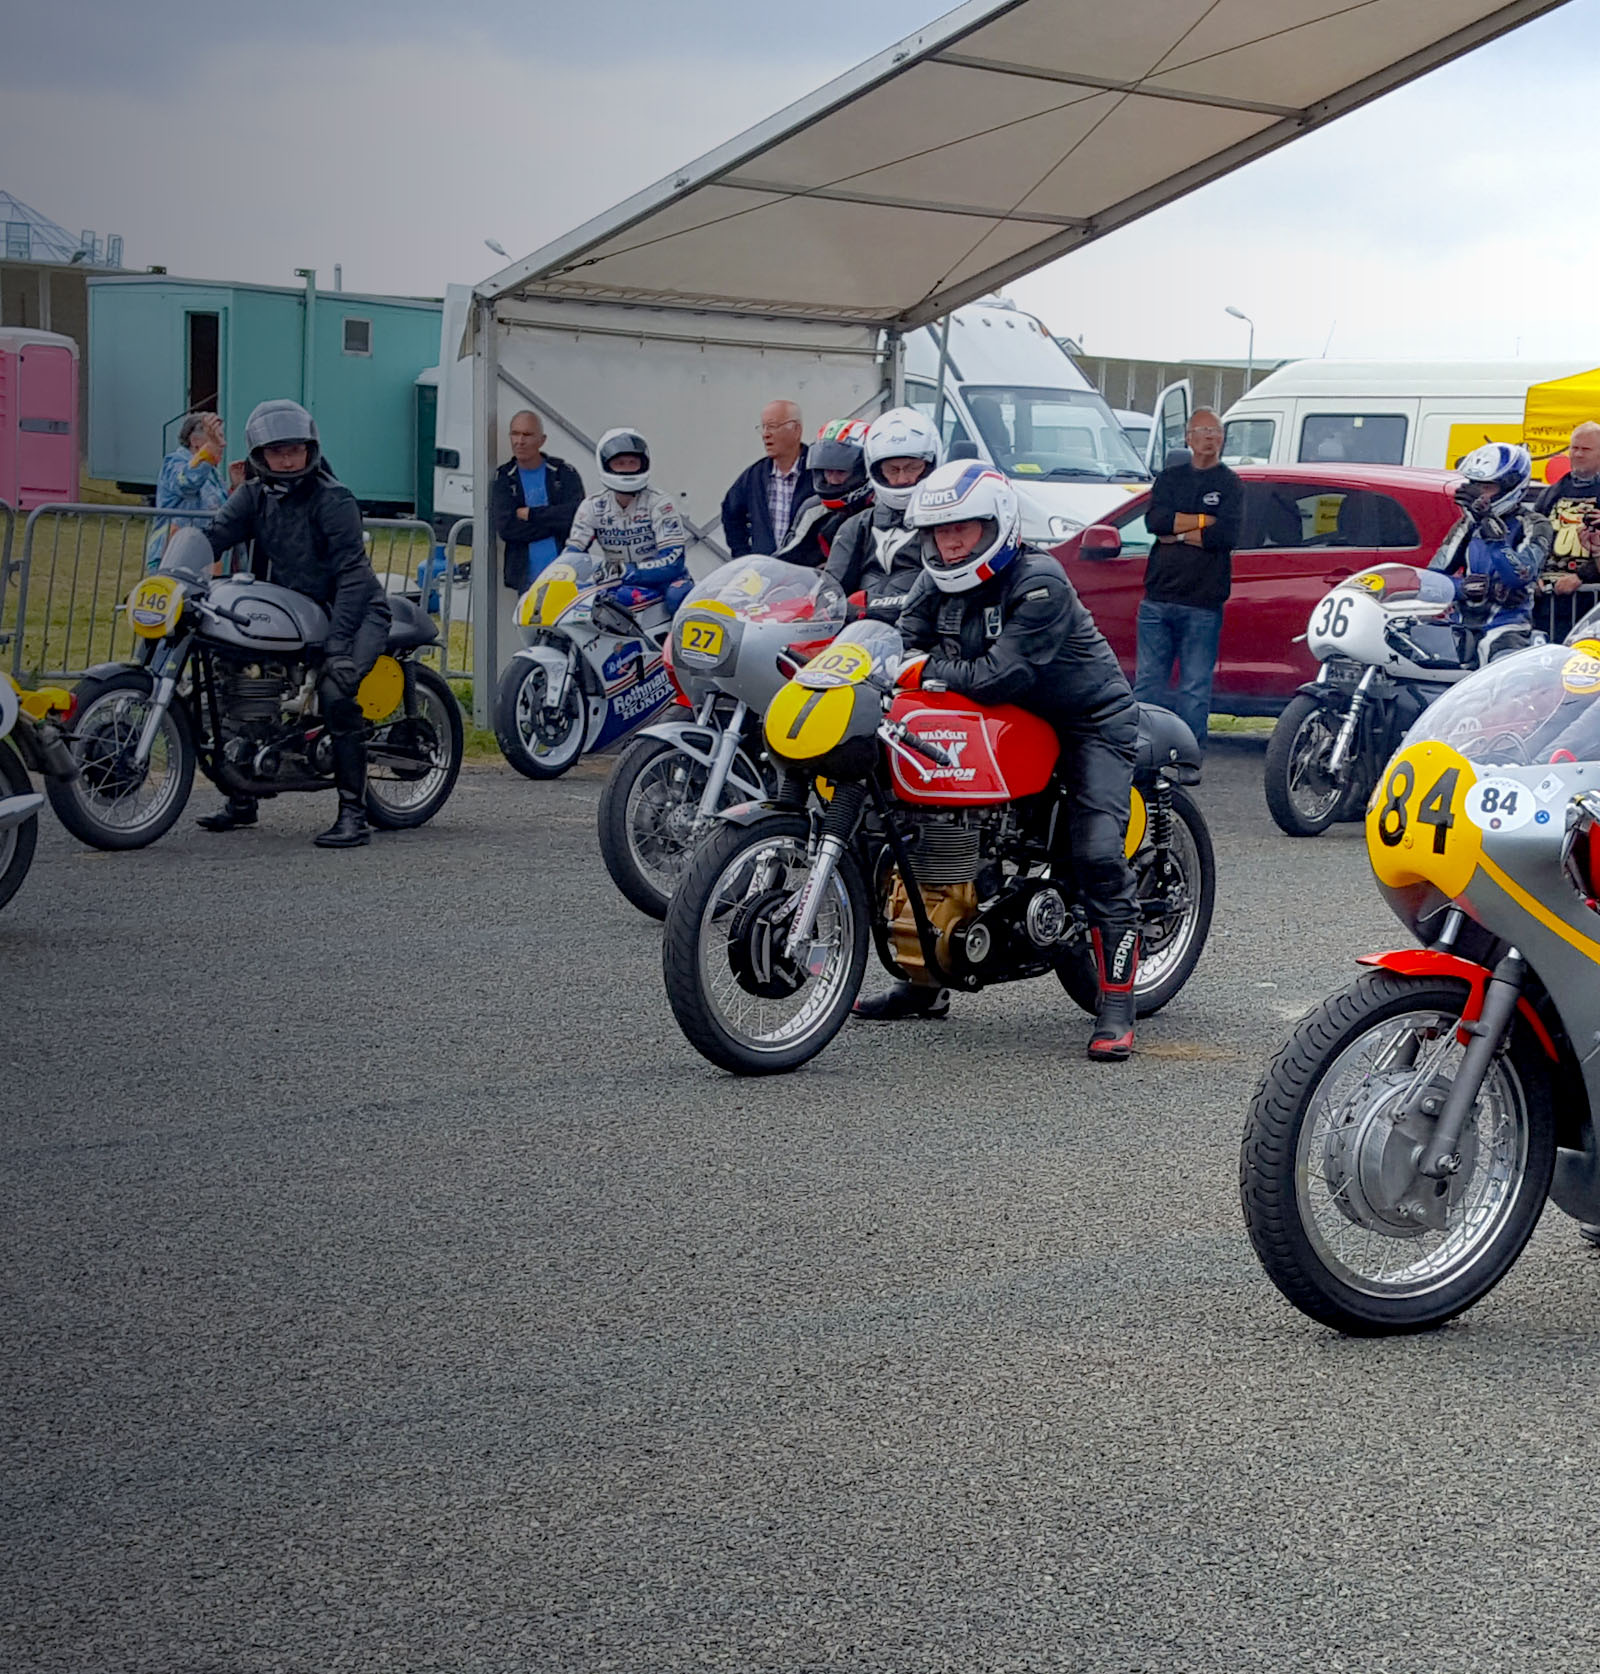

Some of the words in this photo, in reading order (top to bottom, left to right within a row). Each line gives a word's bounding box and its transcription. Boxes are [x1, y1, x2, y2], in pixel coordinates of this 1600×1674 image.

[138, 591, 168, 611] 146
[1315, 596, 1355, 638] 36
[689, 627, 717, 649] 27
[810, 653, 861, 675] 103
[611, 670, 670, 715] Rothman
[1378, 759, 1462, 856] 84
[1480, 787, 1519, 816] 84
